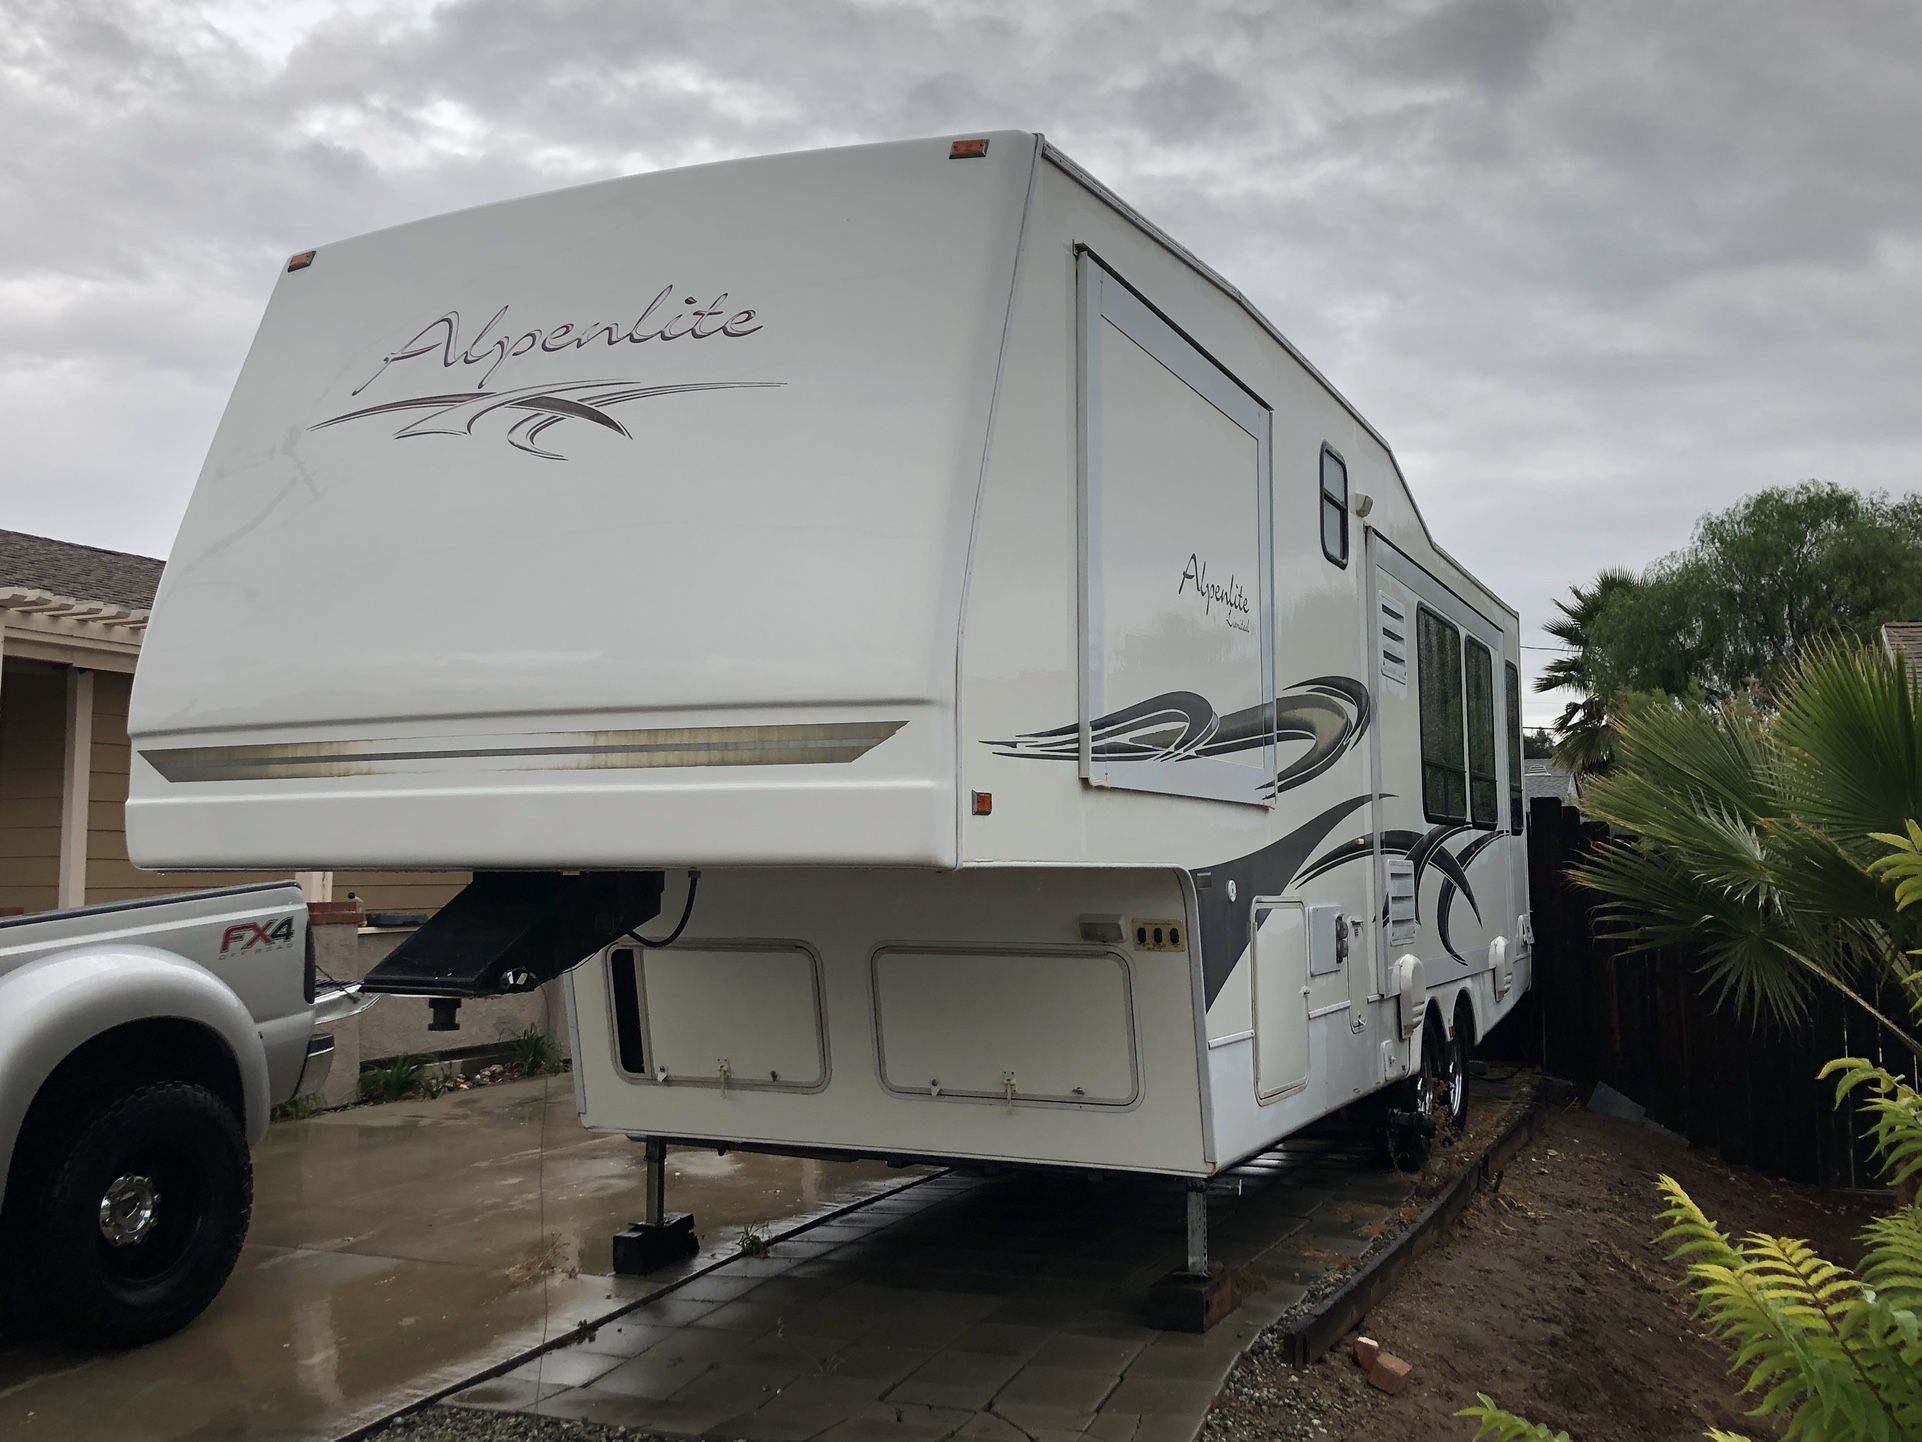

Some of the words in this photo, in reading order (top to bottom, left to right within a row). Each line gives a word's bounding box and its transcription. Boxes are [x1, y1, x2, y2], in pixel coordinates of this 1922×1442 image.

[352, 284, 763, 396] Alpenlite
[1178, 552, 1249, 616] Alpenlite
[219, 915, 295, 953] FX4
